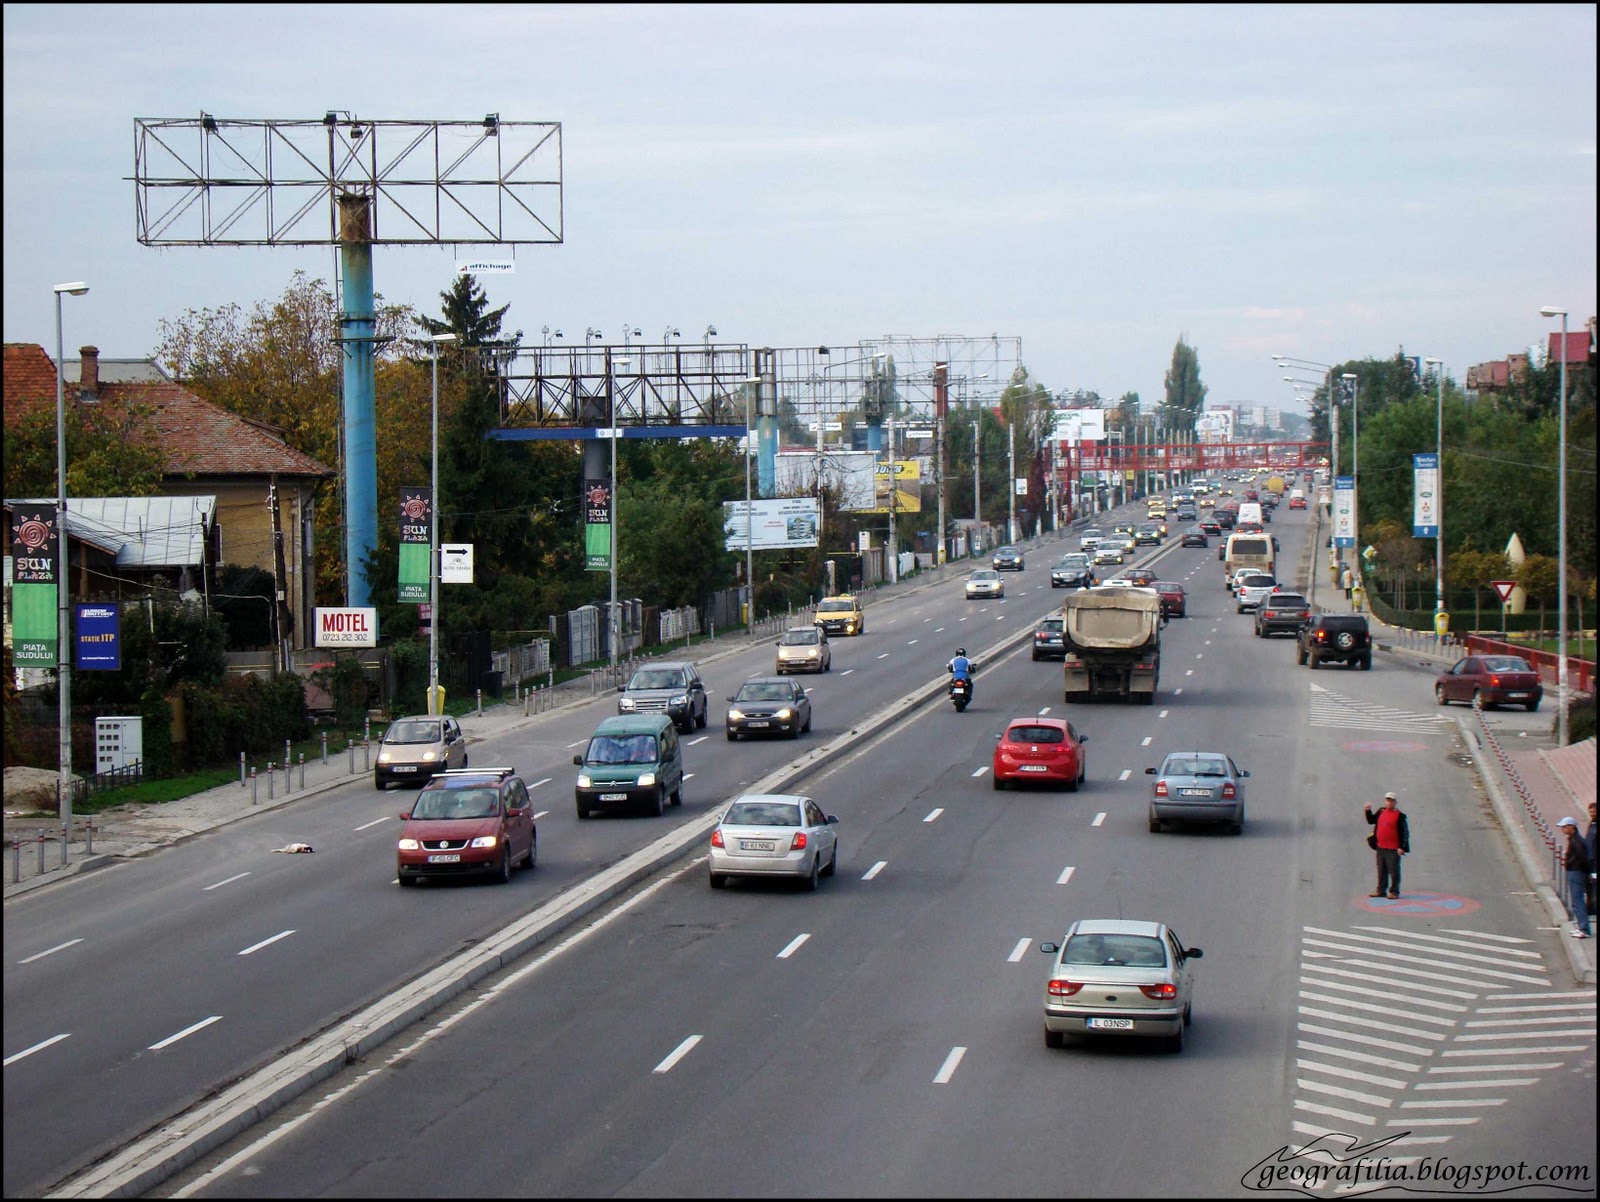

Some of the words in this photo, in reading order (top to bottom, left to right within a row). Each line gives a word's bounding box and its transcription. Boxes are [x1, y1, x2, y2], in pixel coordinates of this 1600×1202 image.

[403, 525, 428, 535] SUN
[16, 557, 53, 571] SUN
[16, 570, 54, 580] PLAZA
[322, 613, 368, 632] MOTEL
[101, 633, 115, 642] ITP
[322, 633, 340, 642] 0723
[341, 633, 353, 642] 212
[354, 633, 368, 642] 302
[16, 651, 53, 659] SUDULUI
